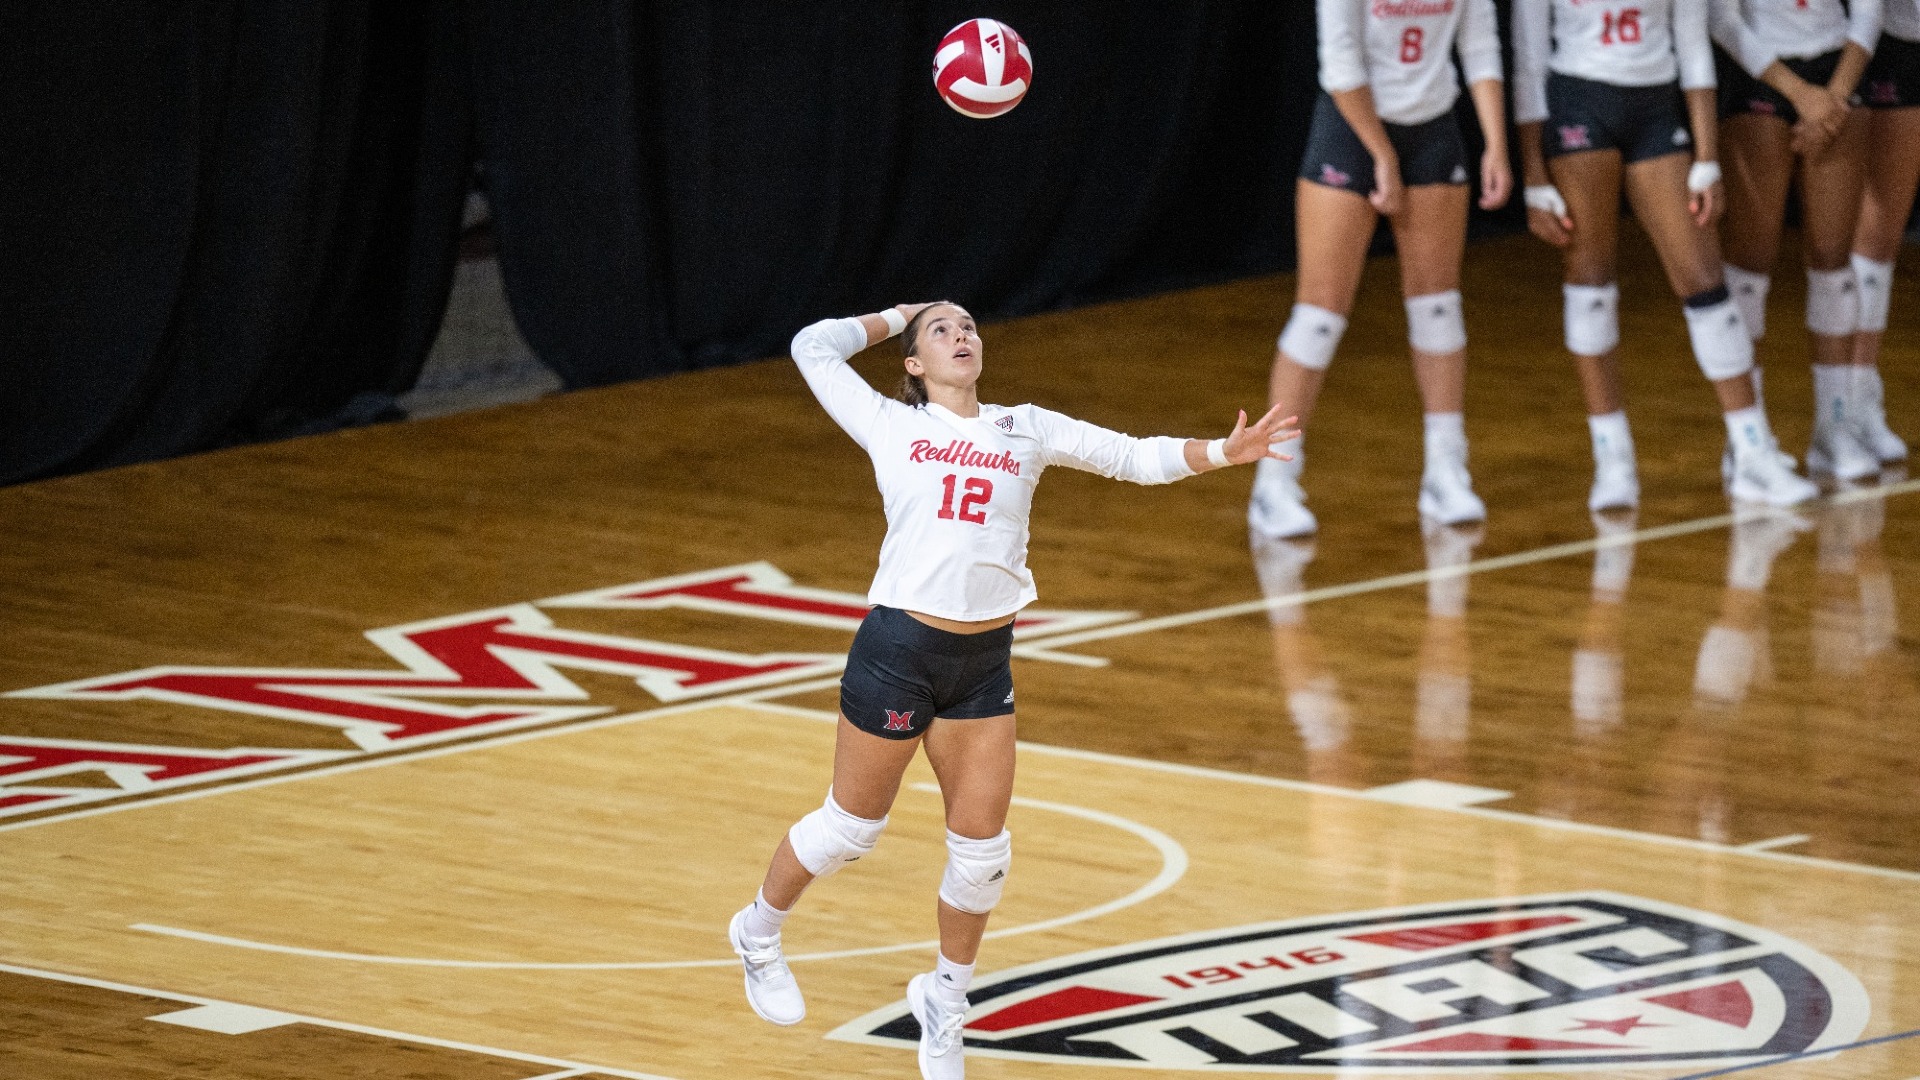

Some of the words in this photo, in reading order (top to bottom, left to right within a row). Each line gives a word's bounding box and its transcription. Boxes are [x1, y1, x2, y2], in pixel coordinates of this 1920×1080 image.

[1400, 26, 1423, 63] 8
[1602, 8, 1641, 45] 16
[910, 439, 1021, 477] RedHawks
[937, 473, 994, 525] 12
[883, 708, 915, 732] M
[1162, 946, 1346, 989] 1946
